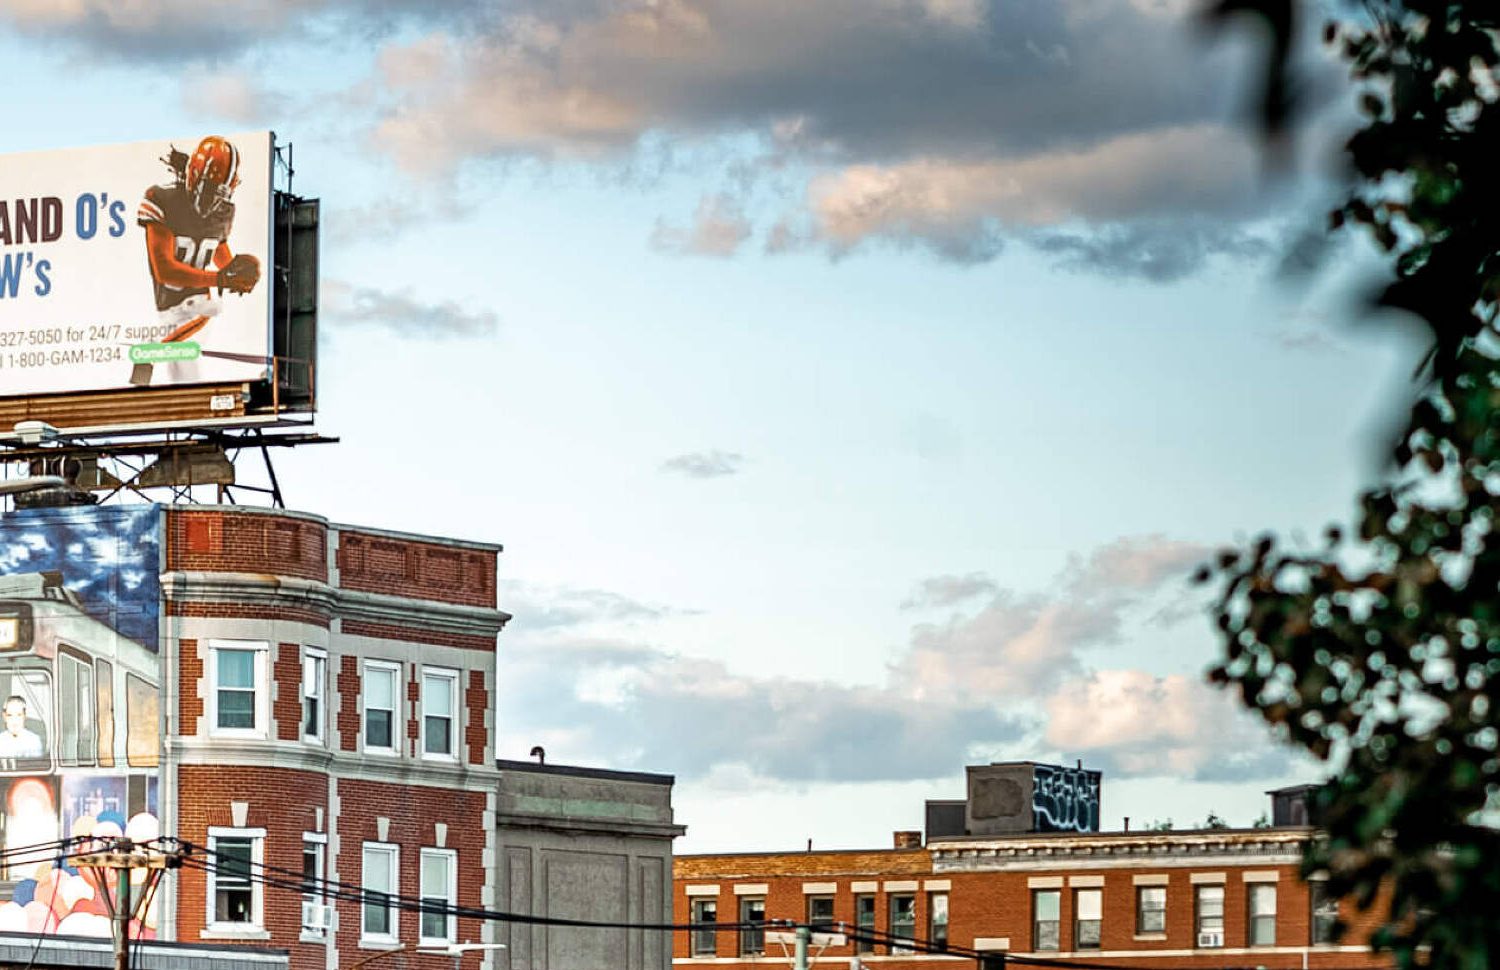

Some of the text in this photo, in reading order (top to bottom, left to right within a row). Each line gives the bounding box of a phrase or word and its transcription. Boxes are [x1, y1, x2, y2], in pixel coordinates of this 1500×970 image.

[75, 192, 126, 240] O's
[67, 326, 84, 342] for
[89, 325, 121, 343] 24/7
